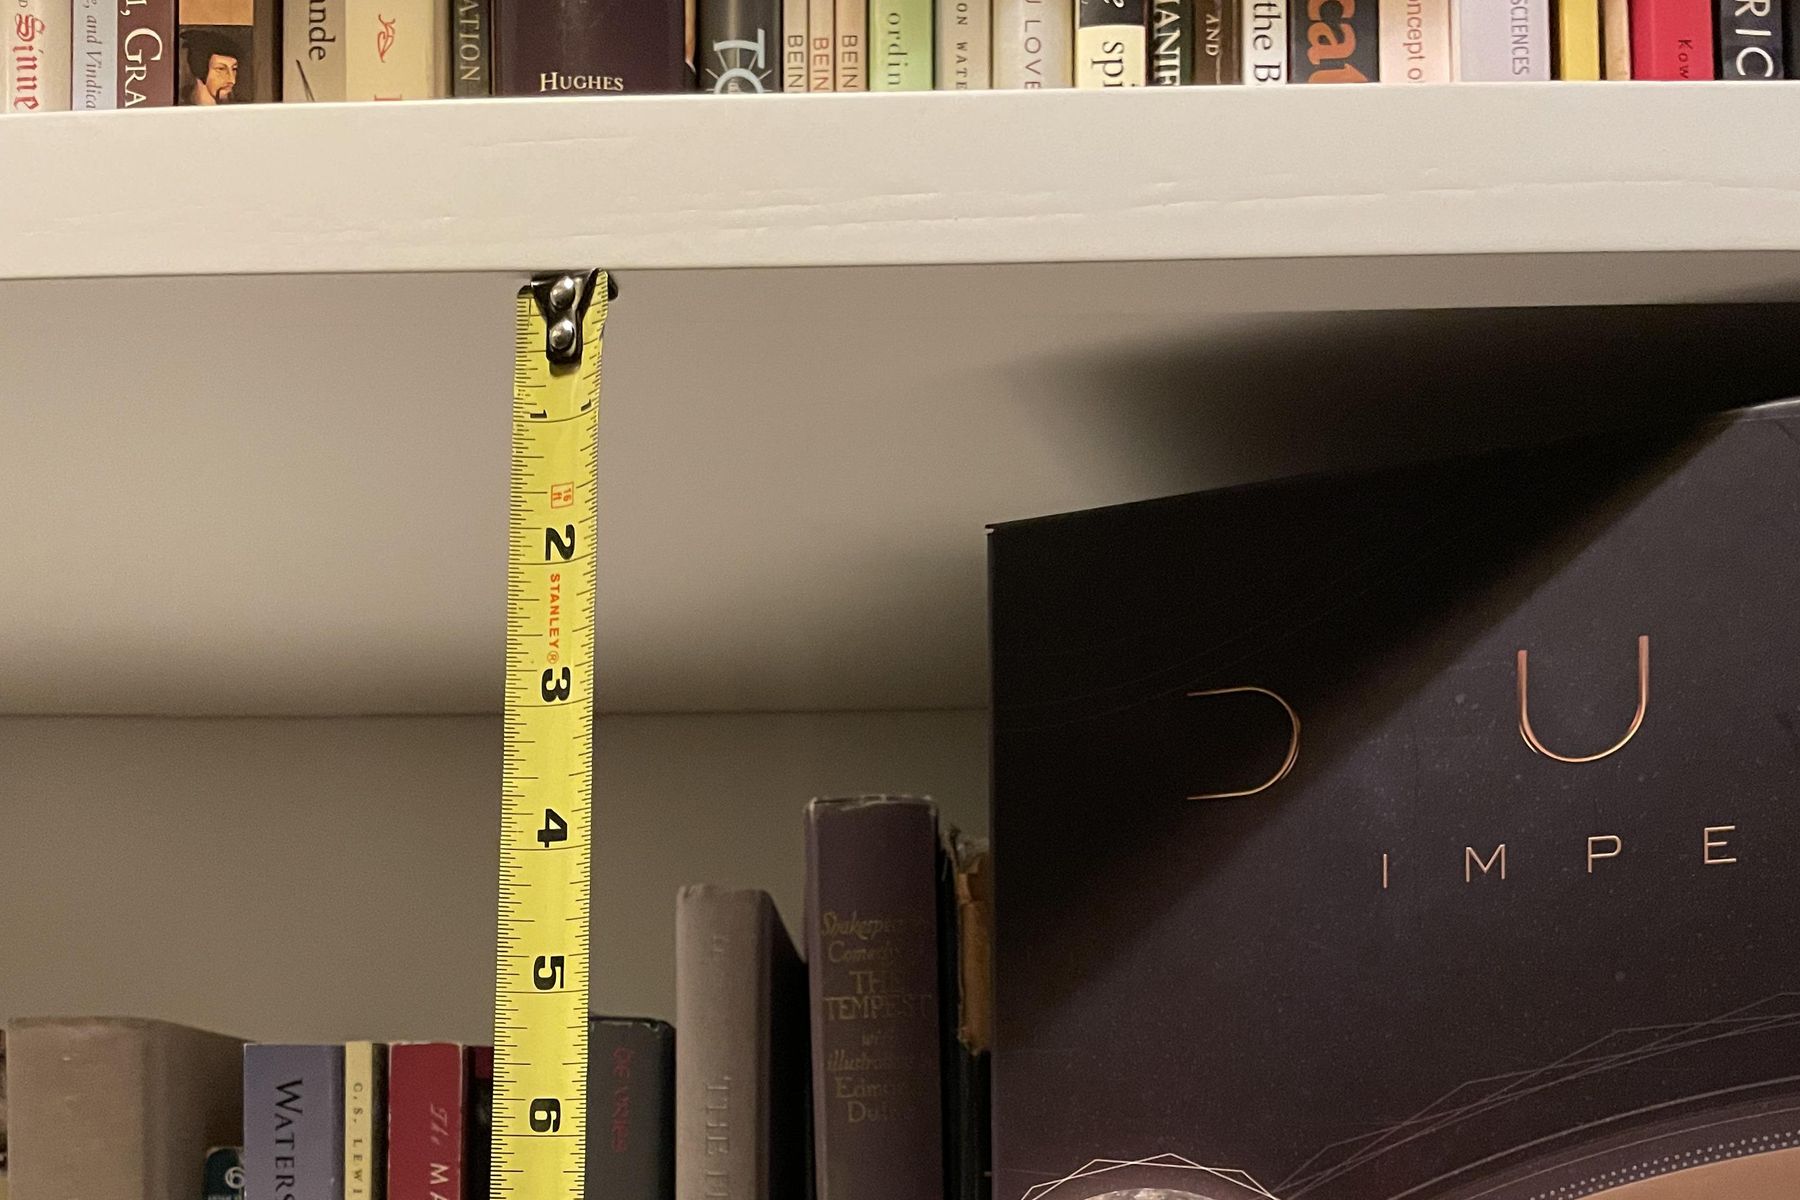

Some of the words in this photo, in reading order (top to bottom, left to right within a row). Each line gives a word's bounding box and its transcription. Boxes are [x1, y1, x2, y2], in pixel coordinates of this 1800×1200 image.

[86, 15, 102, 44] and
[308, 0, 336, 61] nde
[1206, 14, 1221, 56] AND
[1253, 2, 1282, 51] the
[124, 28, 163, 107] GRA
[887, 12, 908, 85] ordin
[545, 524, 576, 561] 2
[541, 666, 571, 702] 3
[537, 808, 568, 848] 4
[533, 955, 565, 990] 5
[529, 1098, 561, 1133] 6
[705, 1076, 732, 1154] THE
